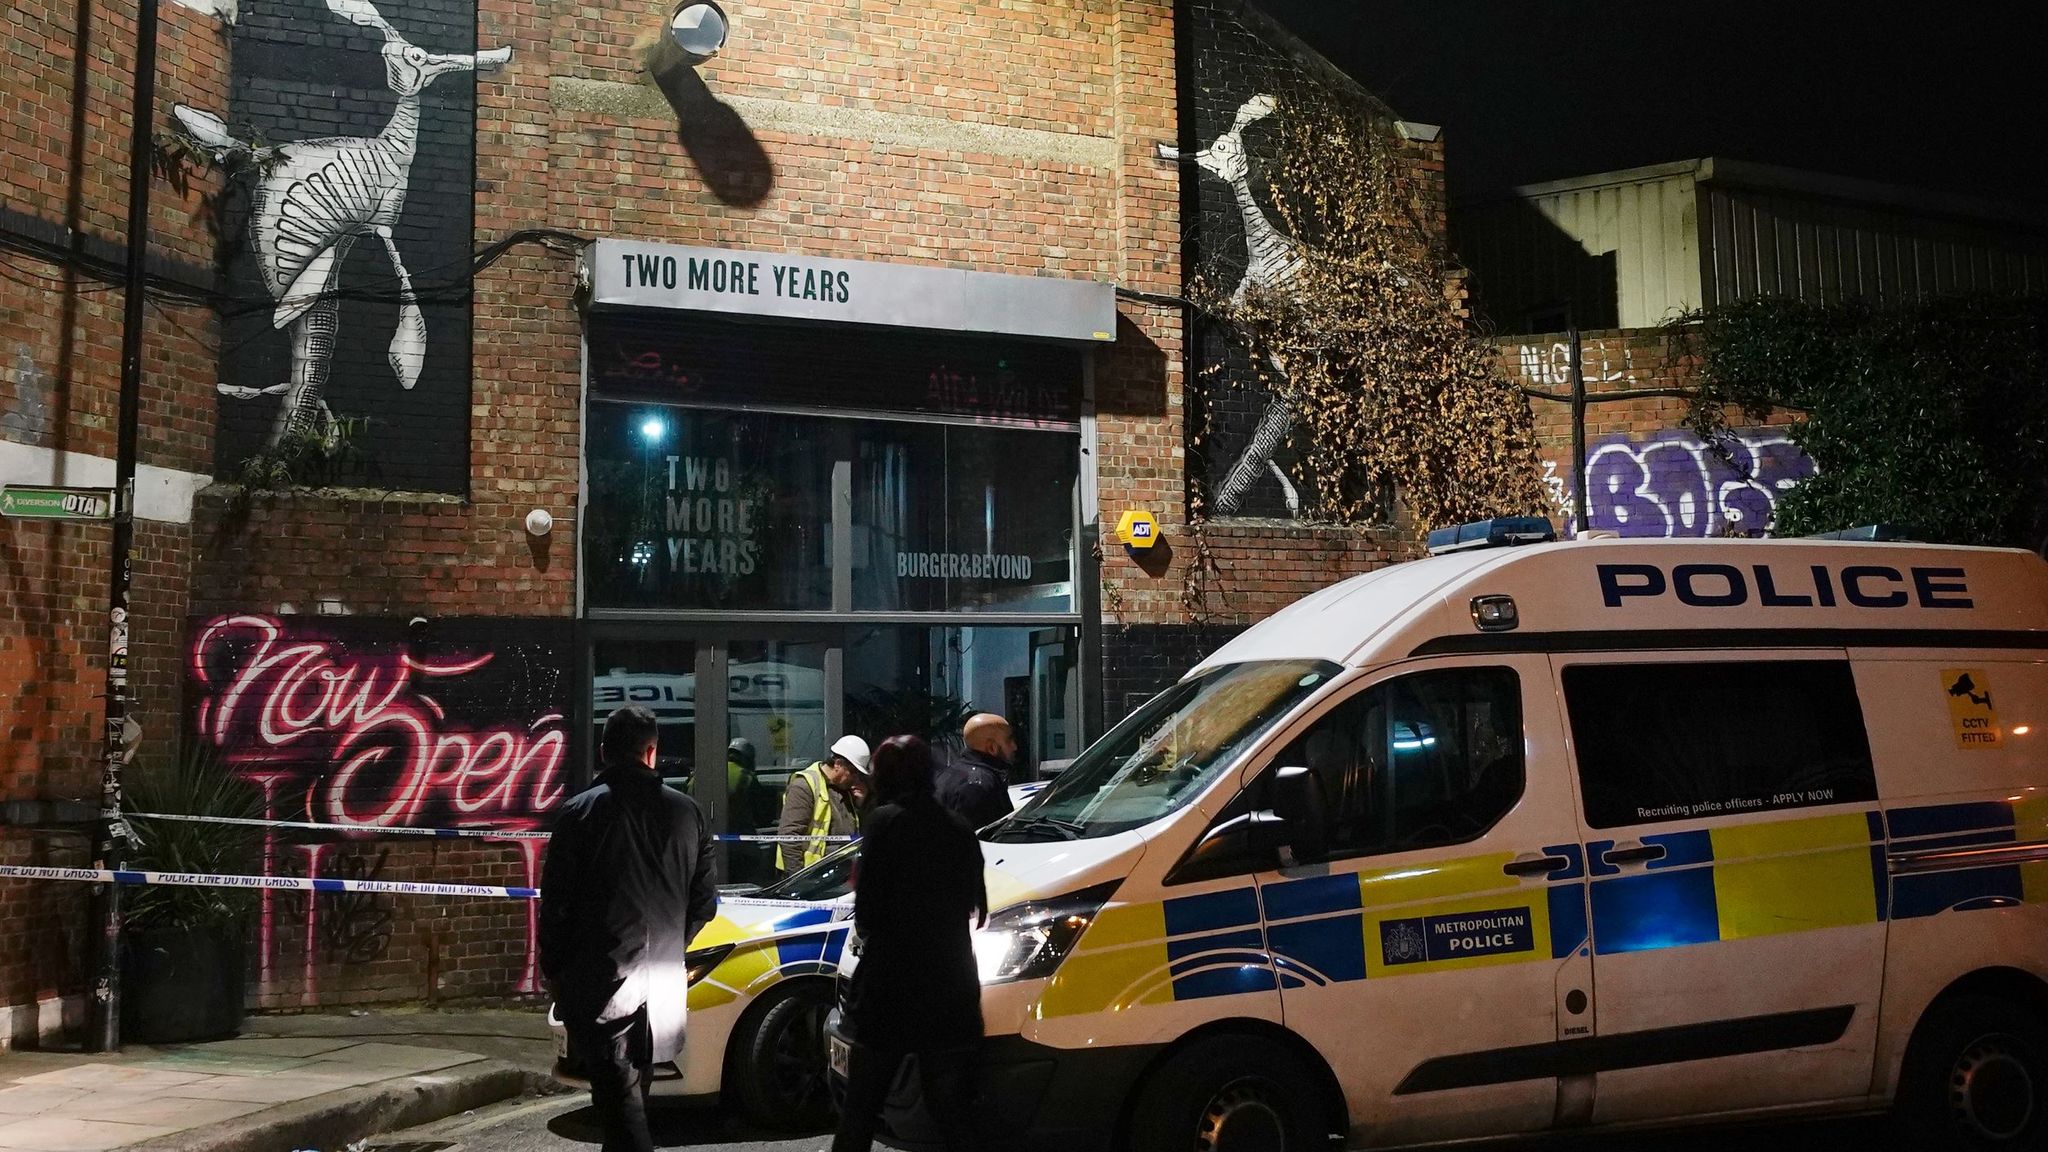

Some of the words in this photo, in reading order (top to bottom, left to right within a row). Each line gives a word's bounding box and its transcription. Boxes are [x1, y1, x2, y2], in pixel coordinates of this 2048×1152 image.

[622, 254, 677, 289] TWO
[688, 257, 759, 295] MORE
[773, 265, 850, 303] YEARS
[666, 455, 730, 492] TWO
[16, 498, 61, 507] DIVERSION
[666, 496, 754, 534] MORE
[1133, 523, 1150, 536] ADT
[667, 537, 756, 575] YEARS
[897, 552, 1032, 580] BURGER&BEYOND
[1597, 563, 1974, 609] POLICE
[1963, 718, 1989, 729] CCTV
[1961, 733, 1996, 743] FITTED
[1637, 806, 1690, 818] Recruiting
[1692, 801, 1722, 814] police
[1725, 797, 1763, 810] officers
[1772, 791, 1804, 805] APPLY
[1808, 789, 1834, 801] NOW
[198, 875, 221, 884] LINE
[357, 881, 392, 891] POLICE
[395, 883, 417, 892] LINE
[460, 886, 493, 896] CROSS
[1435, 915, 1524, 934] METROPOLITAN
[1449, 933, 1514, 951] POLICE
[1564, 1026, 1589, 1035] DIESEL
